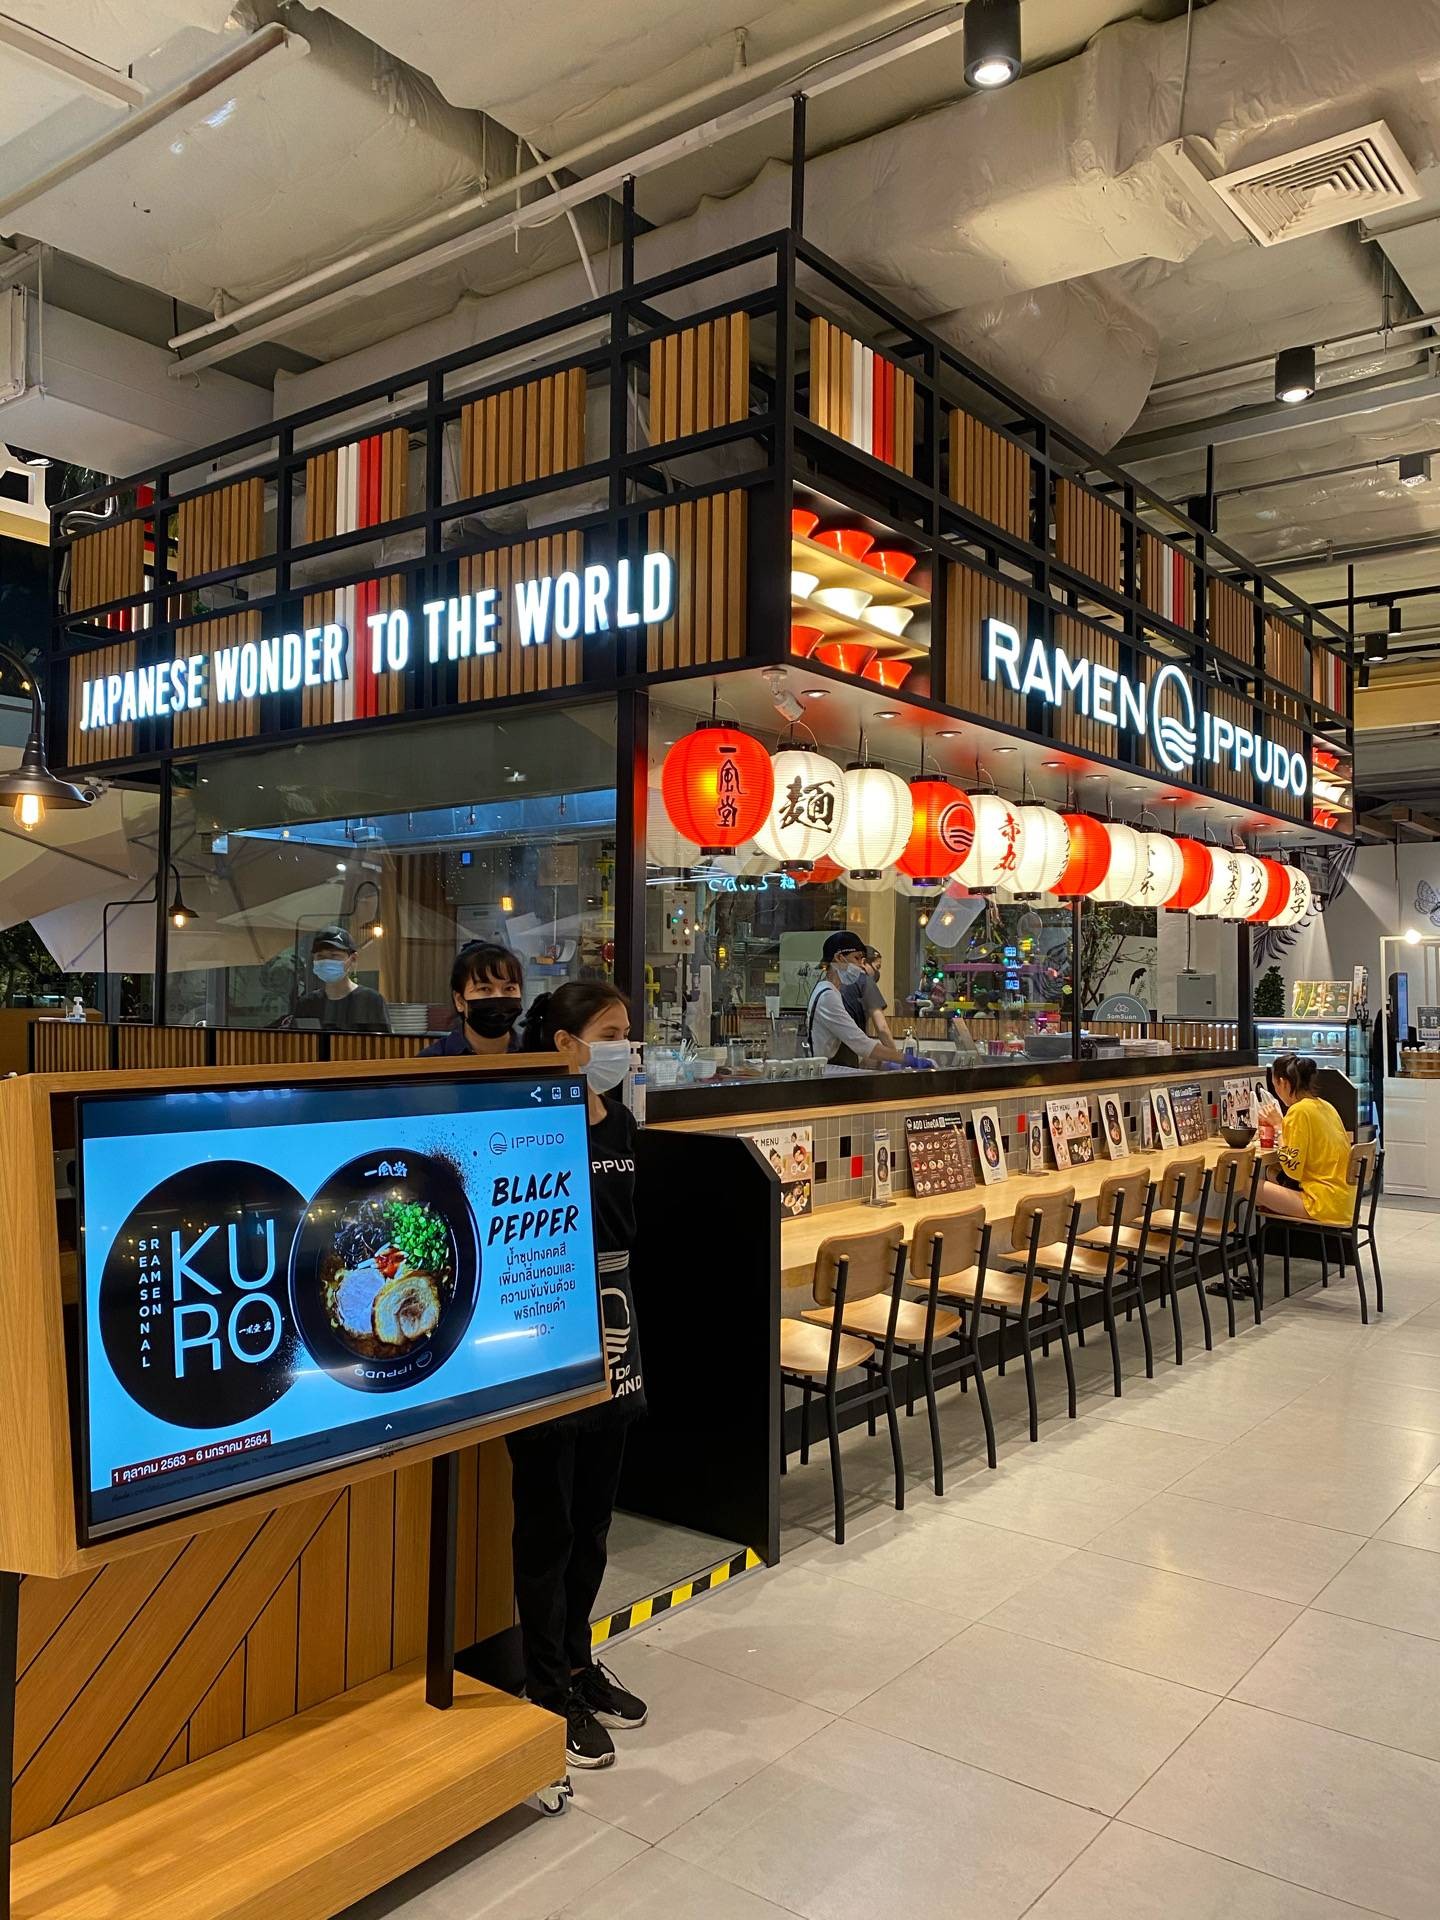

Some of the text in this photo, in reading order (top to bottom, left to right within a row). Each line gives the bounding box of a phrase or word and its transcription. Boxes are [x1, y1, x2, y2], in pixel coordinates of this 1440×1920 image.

[80, 551, 675, 731] JAPANESE WONDER TO THE WORLD
[986, 617, 1308, 796] RAMEN IPPUDO
[716, 746, 744, 828] 一風堂
[993, 812, 1020, 872] 赤丸
[1290, 880, 1307, 914] 餃子
[511, 1132, 565, 1149] IPPUDO
[761, 1136, 780, 1147] MENU
[491, 1170, 571, 1207] BLACK
[487, 1204, 579, 1247] PEPPER
[150, 1239, 162, 1315] RAMEN
[171, 1219, 276, 1301] KU
[138, 1240, 150, 1368] SEASONAL
[173, 1293, 282, 1379] RO
[354, 1364, 412, 1379] IPPUDO
[113, 1472, 120, 1483] 1
[123, 1462, 158, 1483] ตุลาคม
[160, 1454, 187, 1474] 2563
[196, 1450, 203, 1462] 6
[205, 1442, 243, 1460] มกราคม
[245, 1434, 269, 1451] 2564
